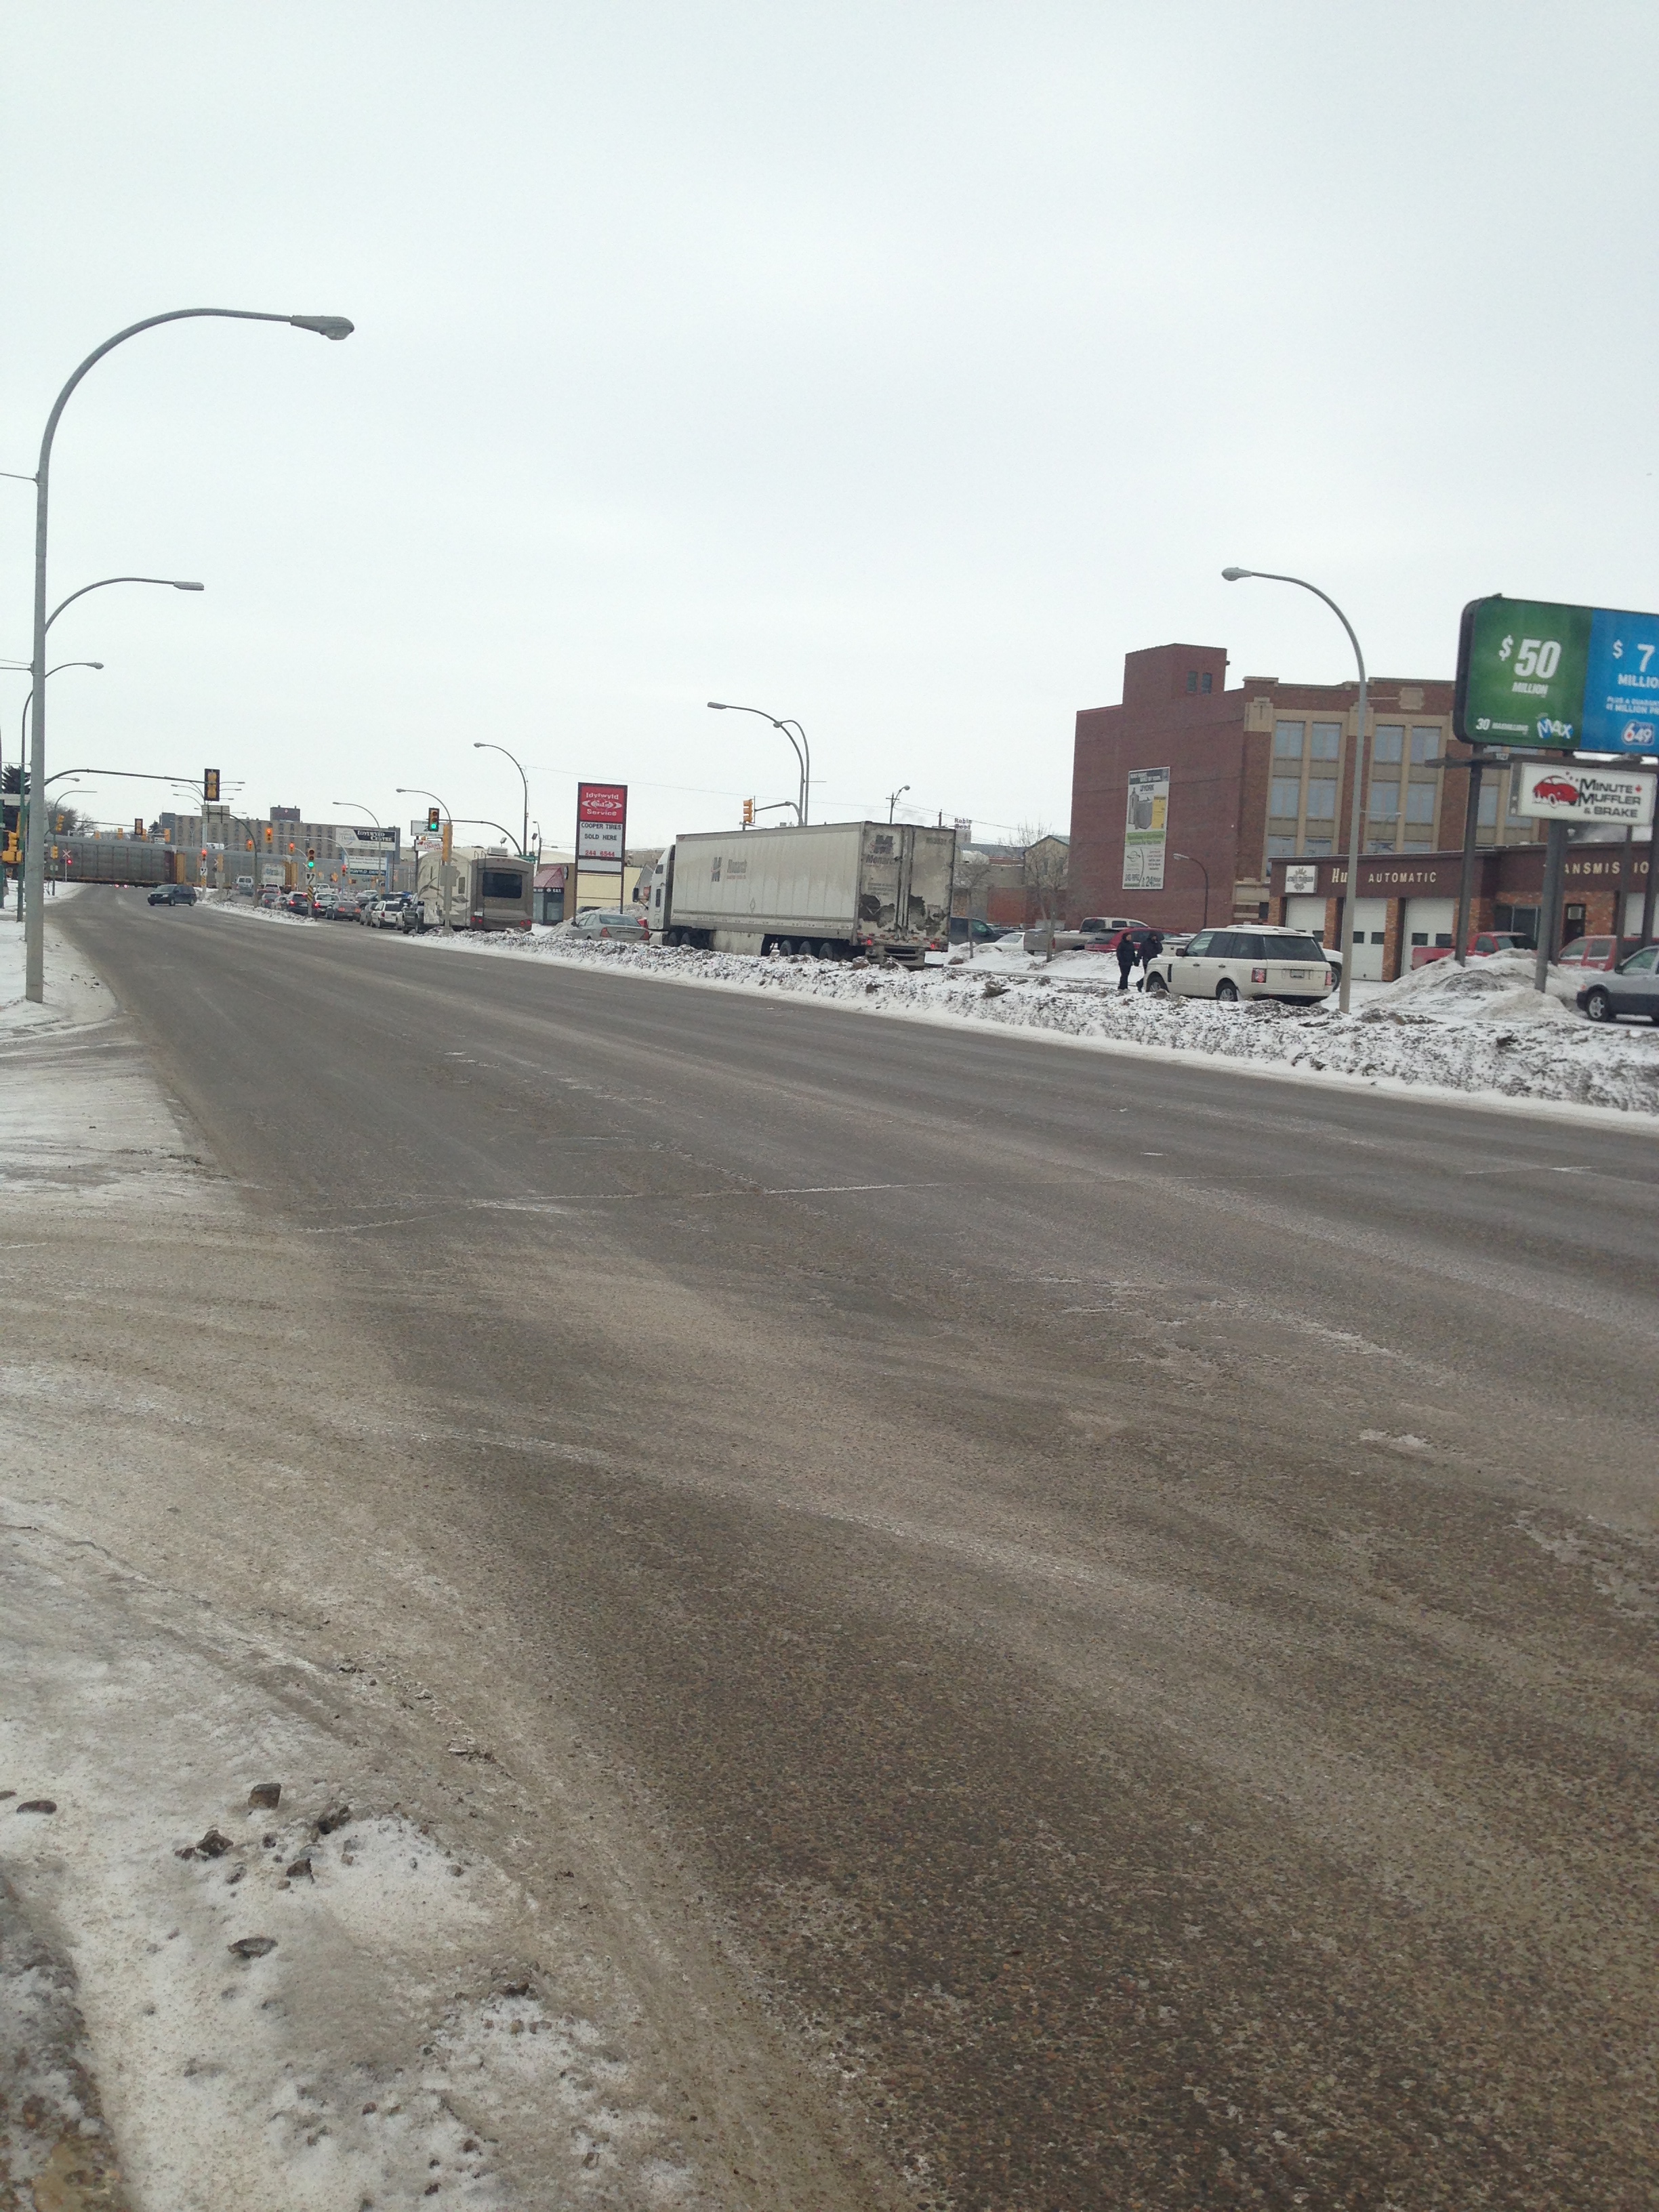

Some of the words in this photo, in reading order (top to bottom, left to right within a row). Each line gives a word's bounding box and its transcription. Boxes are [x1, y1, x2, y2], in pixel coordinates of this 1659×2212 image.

[1618, 673, 1659, 689] MILLIO
[1511, 682, 1549, 695] MILLION
[1475, 718, 1491, 731] 30
[1578, 792, 1641, 807] MUFFLER
[1594, 806, 1638, 818] BRAKE
[1332, 867, 1348, 883] Hu
[1368, 872, 1437, 883] AUTOMATIC
